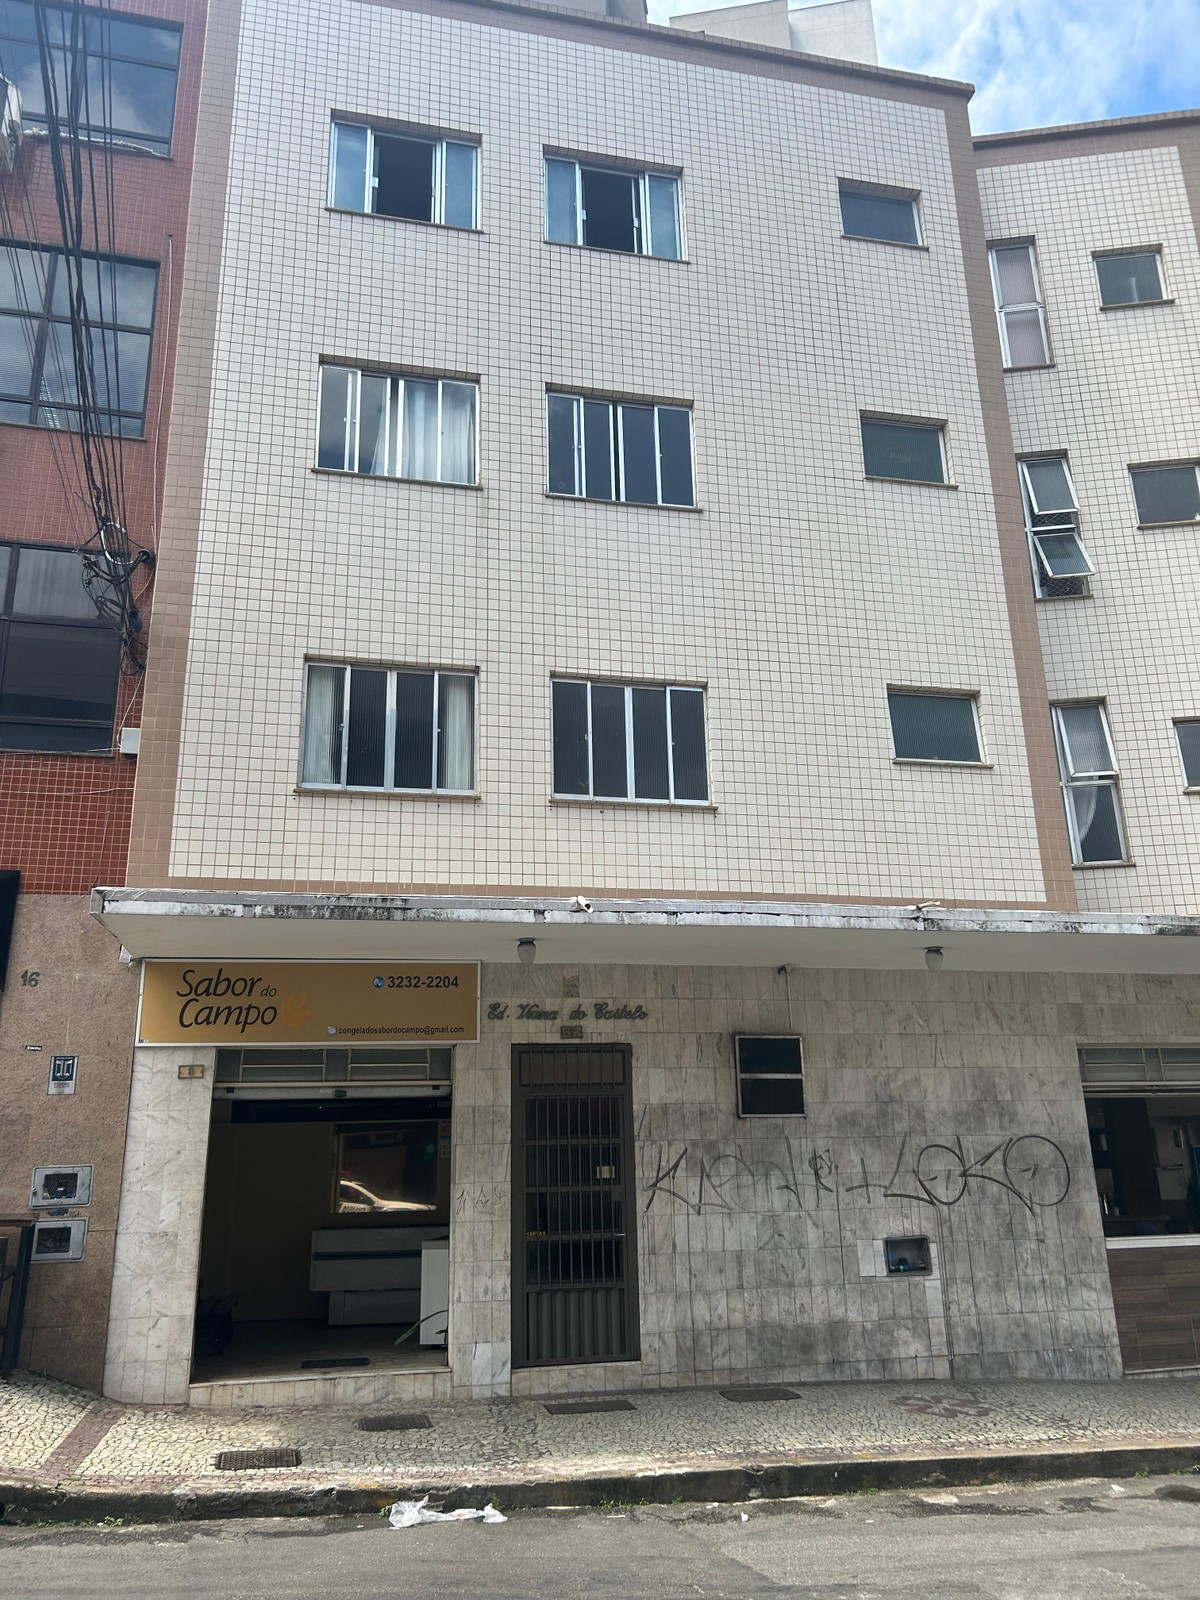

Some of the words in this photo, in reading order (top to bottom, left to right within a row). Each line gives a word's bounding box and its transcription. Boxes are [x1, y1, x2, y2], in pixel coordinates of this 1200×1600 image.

[20, 969, 41, 988] 16
[175, 967, 263, 998] Sabor
[260, 985, 278, 998] do
[386, 975, 460, 989] 3232-2204
[178, 997, 278, 1034] Campo
[515, 1003, 559, 1021] Viana
[569, 1004, 588, 1021] do
[593, 1001, 649, 1021] Castelo
[338, 1025, 465, 1036] congeladosabordocampo@gmail.com
